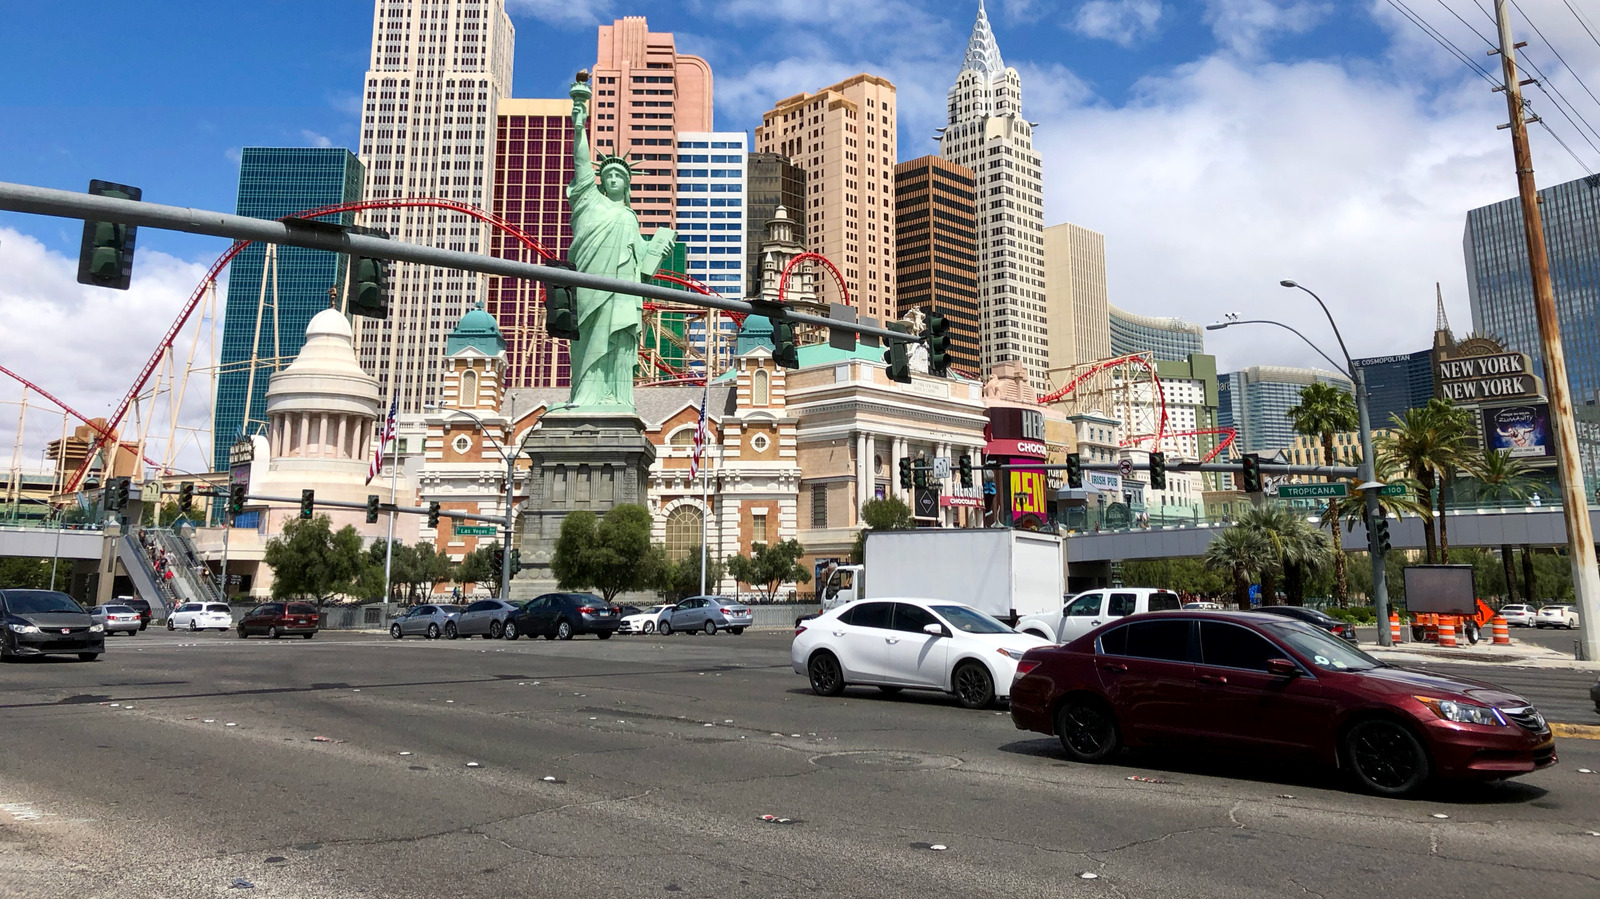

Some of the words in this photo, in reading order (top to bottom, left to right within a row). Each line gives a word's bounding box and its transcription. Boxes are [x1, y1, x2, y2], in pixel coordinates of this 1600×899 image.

[1361, 354, 1410, 366] COSMOPOLITAN
[1440, 360, 1474, 379] NEW
[1478, 355, 1522, 375] YORK
[1442, 381, 1476, 400] NEW
[1481, 377, 1525, 396] YORK
[1091, 475, 1106, 485] IRISH
[1107, 477, 1118, 487] PUB
[1288, 487, 1336, 496] TROPICANA
